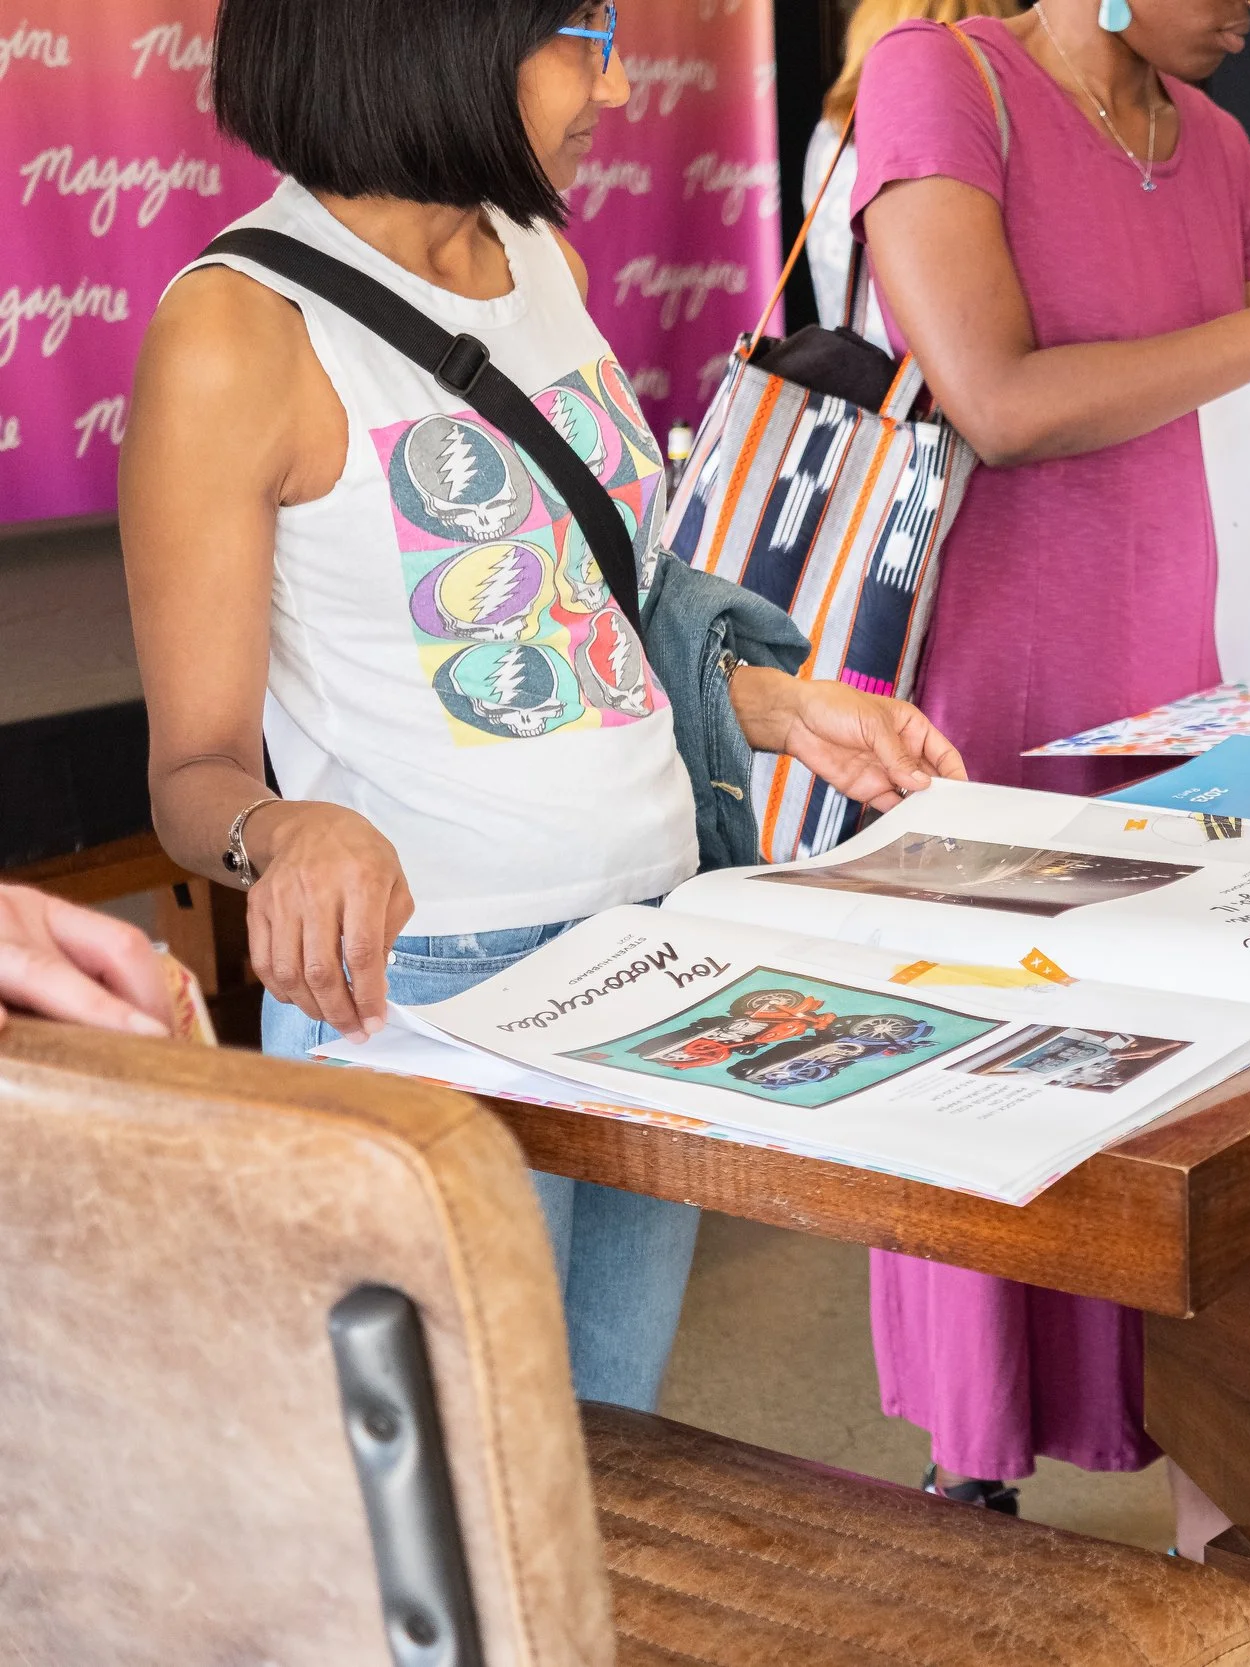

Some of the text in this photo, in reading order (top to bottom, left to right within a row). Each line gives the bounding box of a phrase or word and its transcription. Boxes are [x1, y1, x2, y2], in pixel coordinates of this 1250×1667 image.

[20, 144, 222, 238] Magazine
[495, 941, 680, 1034] Motorcycles
[567, 935, 648, 987] STEVEN HUBBARD
[663, 956, 731, 989] Toy
